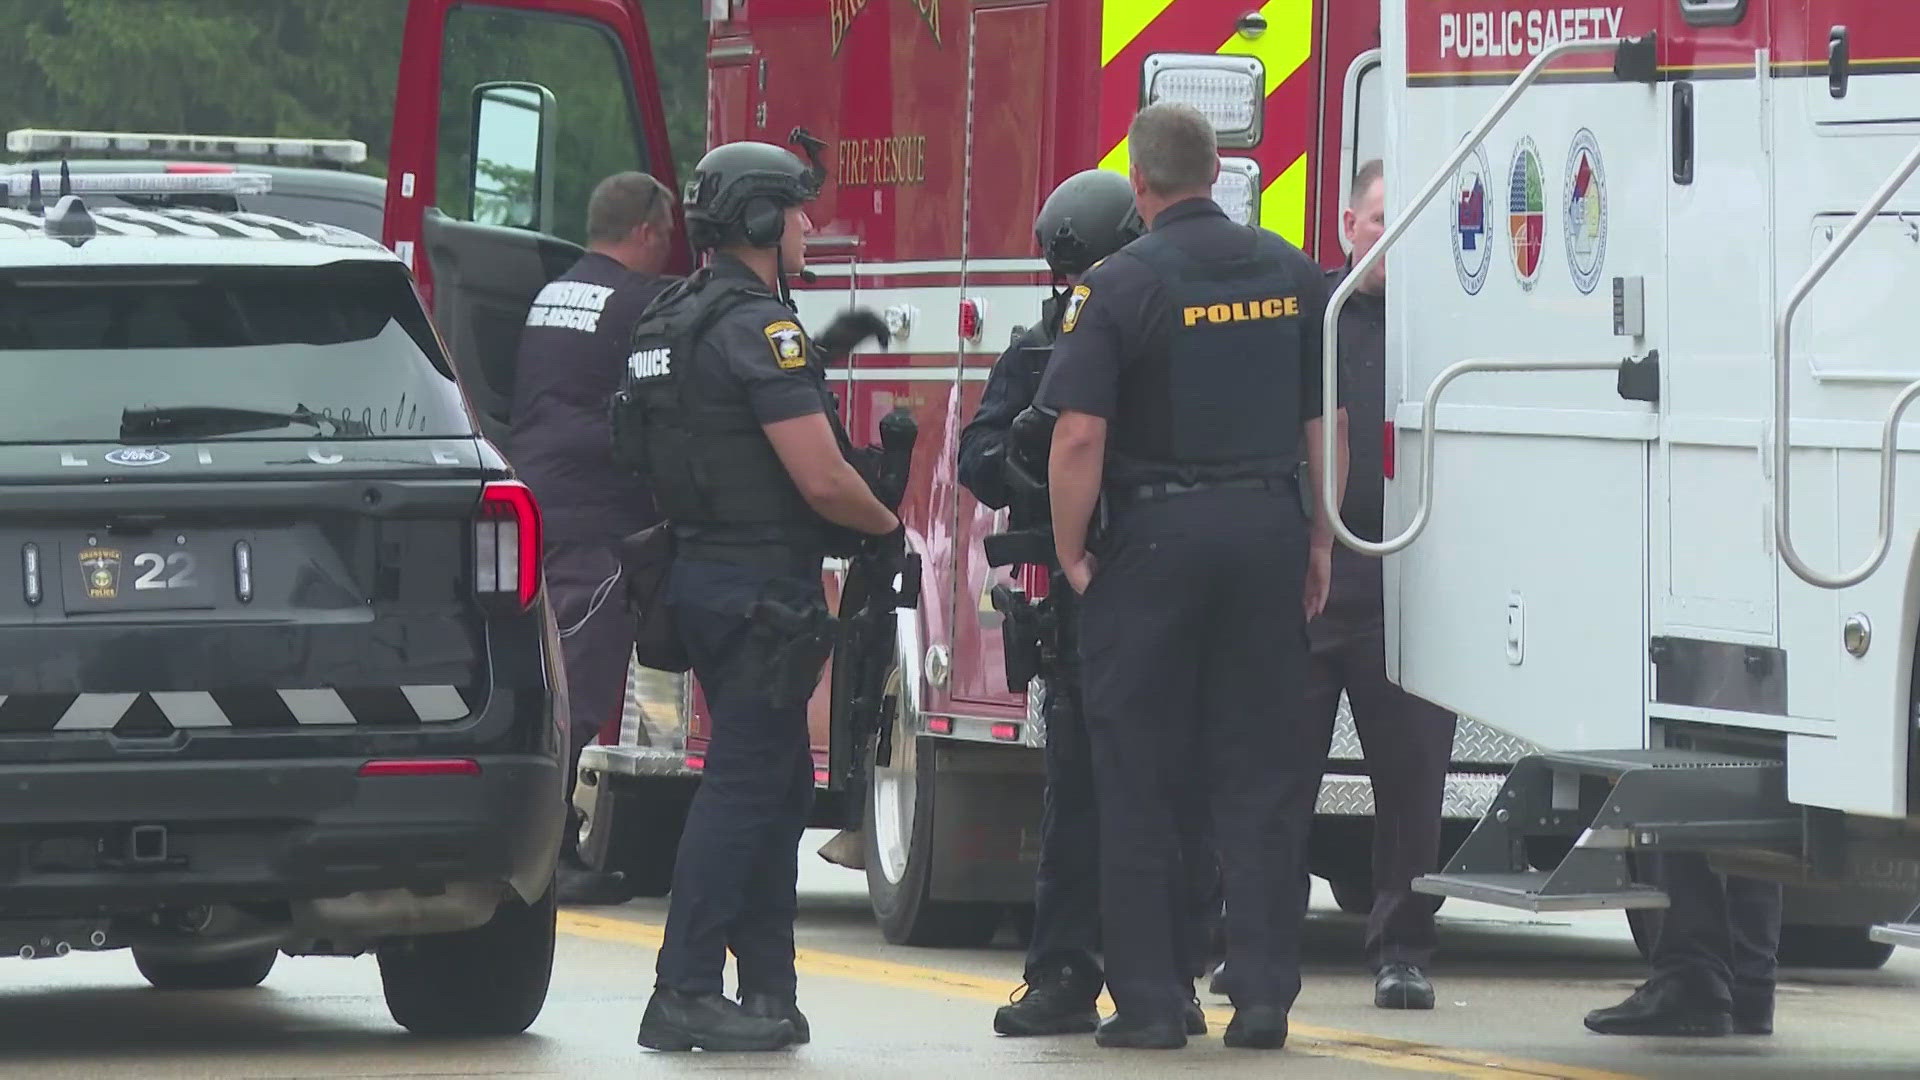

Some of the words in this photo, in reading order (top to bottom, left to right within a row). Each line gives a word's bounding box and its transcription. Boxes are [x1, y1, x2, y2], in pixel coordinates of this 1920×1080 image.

[1440, 11, 1522, 59] PUBLIC
[1527, 7, 1623, 55] SAFETY
[1183, 297, 1299, 326] POLICE
[134, 551, 198, 590] 22
